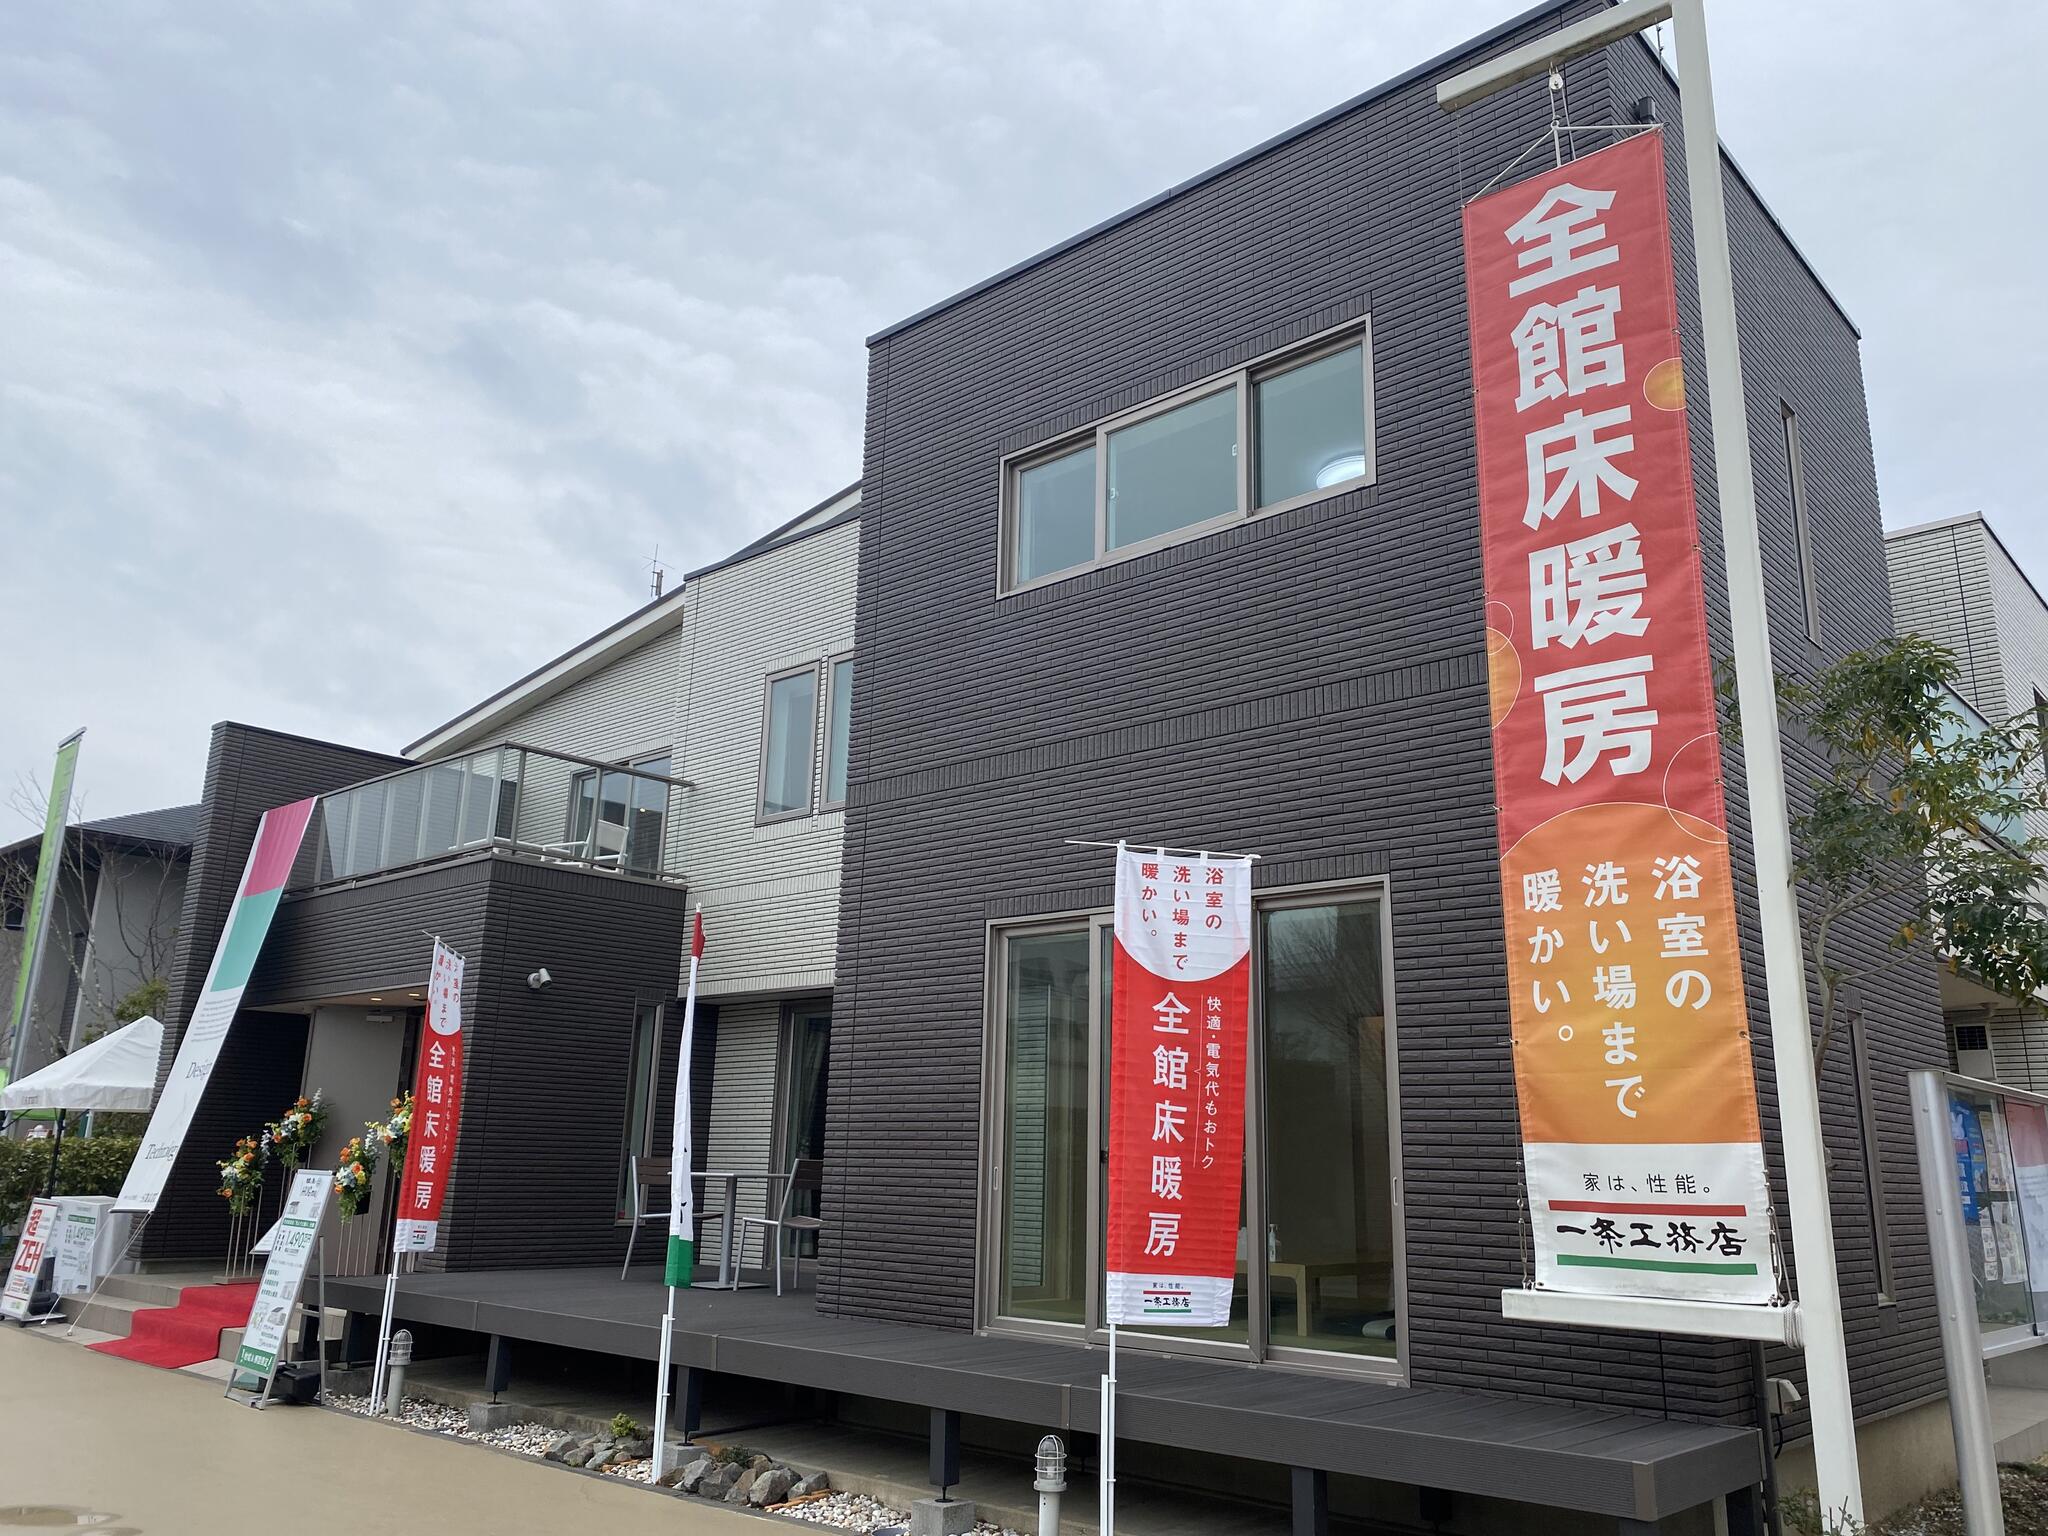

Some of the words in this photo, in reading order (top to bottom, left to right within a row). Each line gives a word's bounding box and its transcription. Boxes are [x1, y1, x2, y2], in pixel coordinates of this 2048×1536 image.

[1504, 181, 1659, 785] 全館床暖房
[1141, 862, 1160, 937] 暖かい。
[1172, 865, 1191, 971] 洗い場まで
[1205, 866, 1224, 931] 浴室の
[1650, 854, 1712, 1011] 浴室の
[1522, 867, 1574, 1042] 暖かい。
[1579, 861, 1646, 1119] 洗い場まで
[1143, 991, 1192, 1257] 全館床暖房
[1201, 995, 1222, 1169] 快適・電気代もおトク
[1583, 1171, 1712, 1195] 家は、性能。
[15, 1239, 44, 1273] ZEH
[1555, 1217, 1748, 1257] 一条工務店
[1144, 1296, 1191, 1308] 一条工務店
